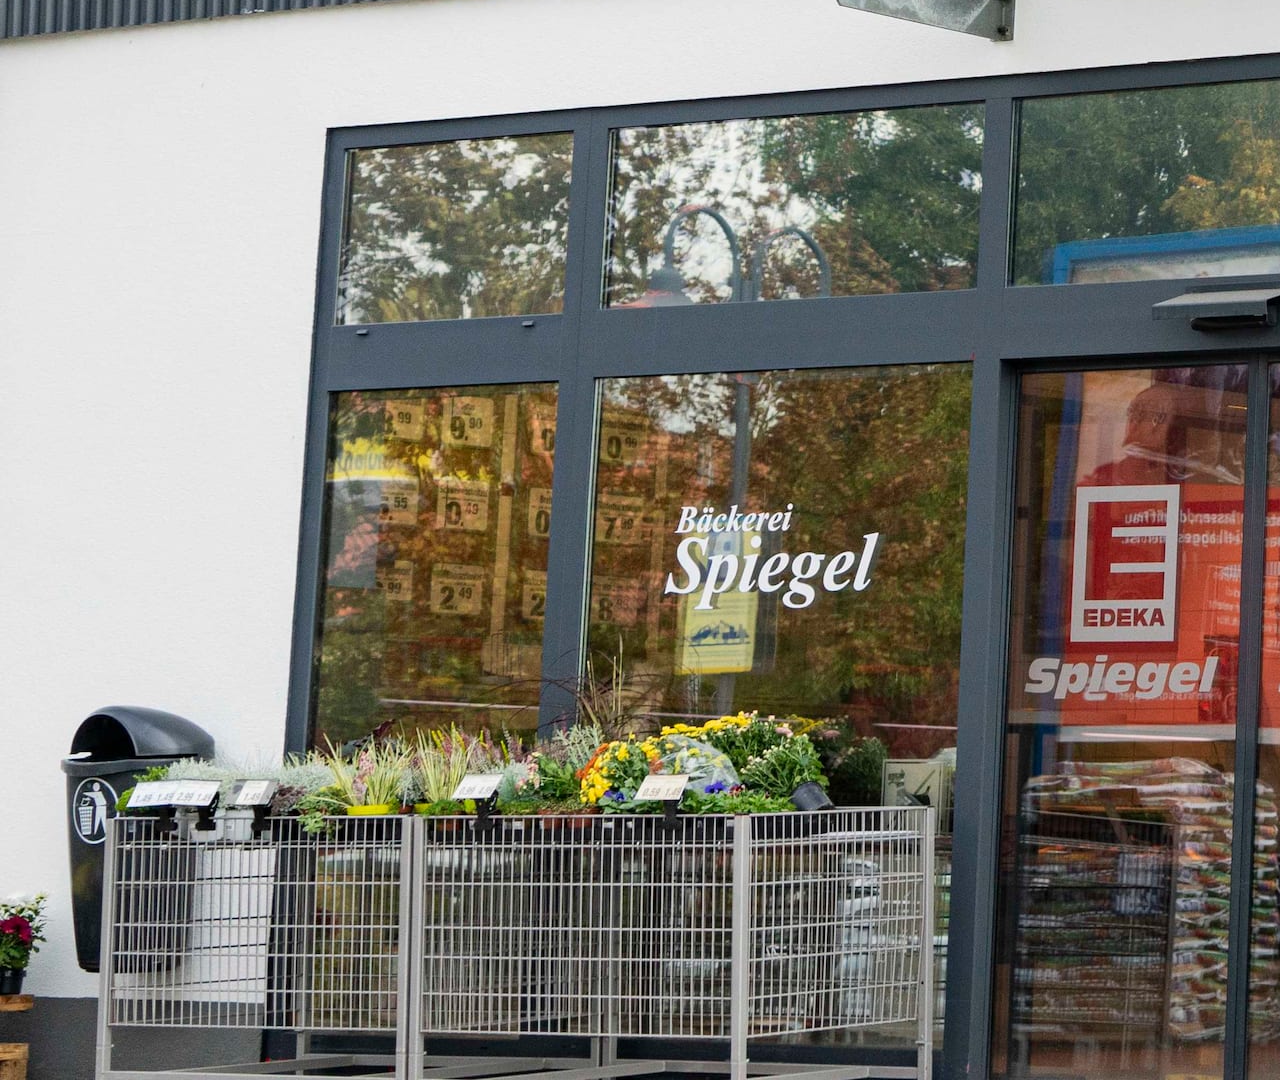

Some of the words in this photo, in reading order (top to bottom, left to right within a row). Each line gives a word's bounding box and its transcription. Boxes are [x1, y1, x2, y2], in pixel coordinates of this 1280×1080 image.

[675, 503, 794, 534] Bäckerei
[664, 532, 879, 610] Spiegel
[1083, 608, 1165, 627] EDEKA
[1025, 655, 1219, 701] Spiegel
